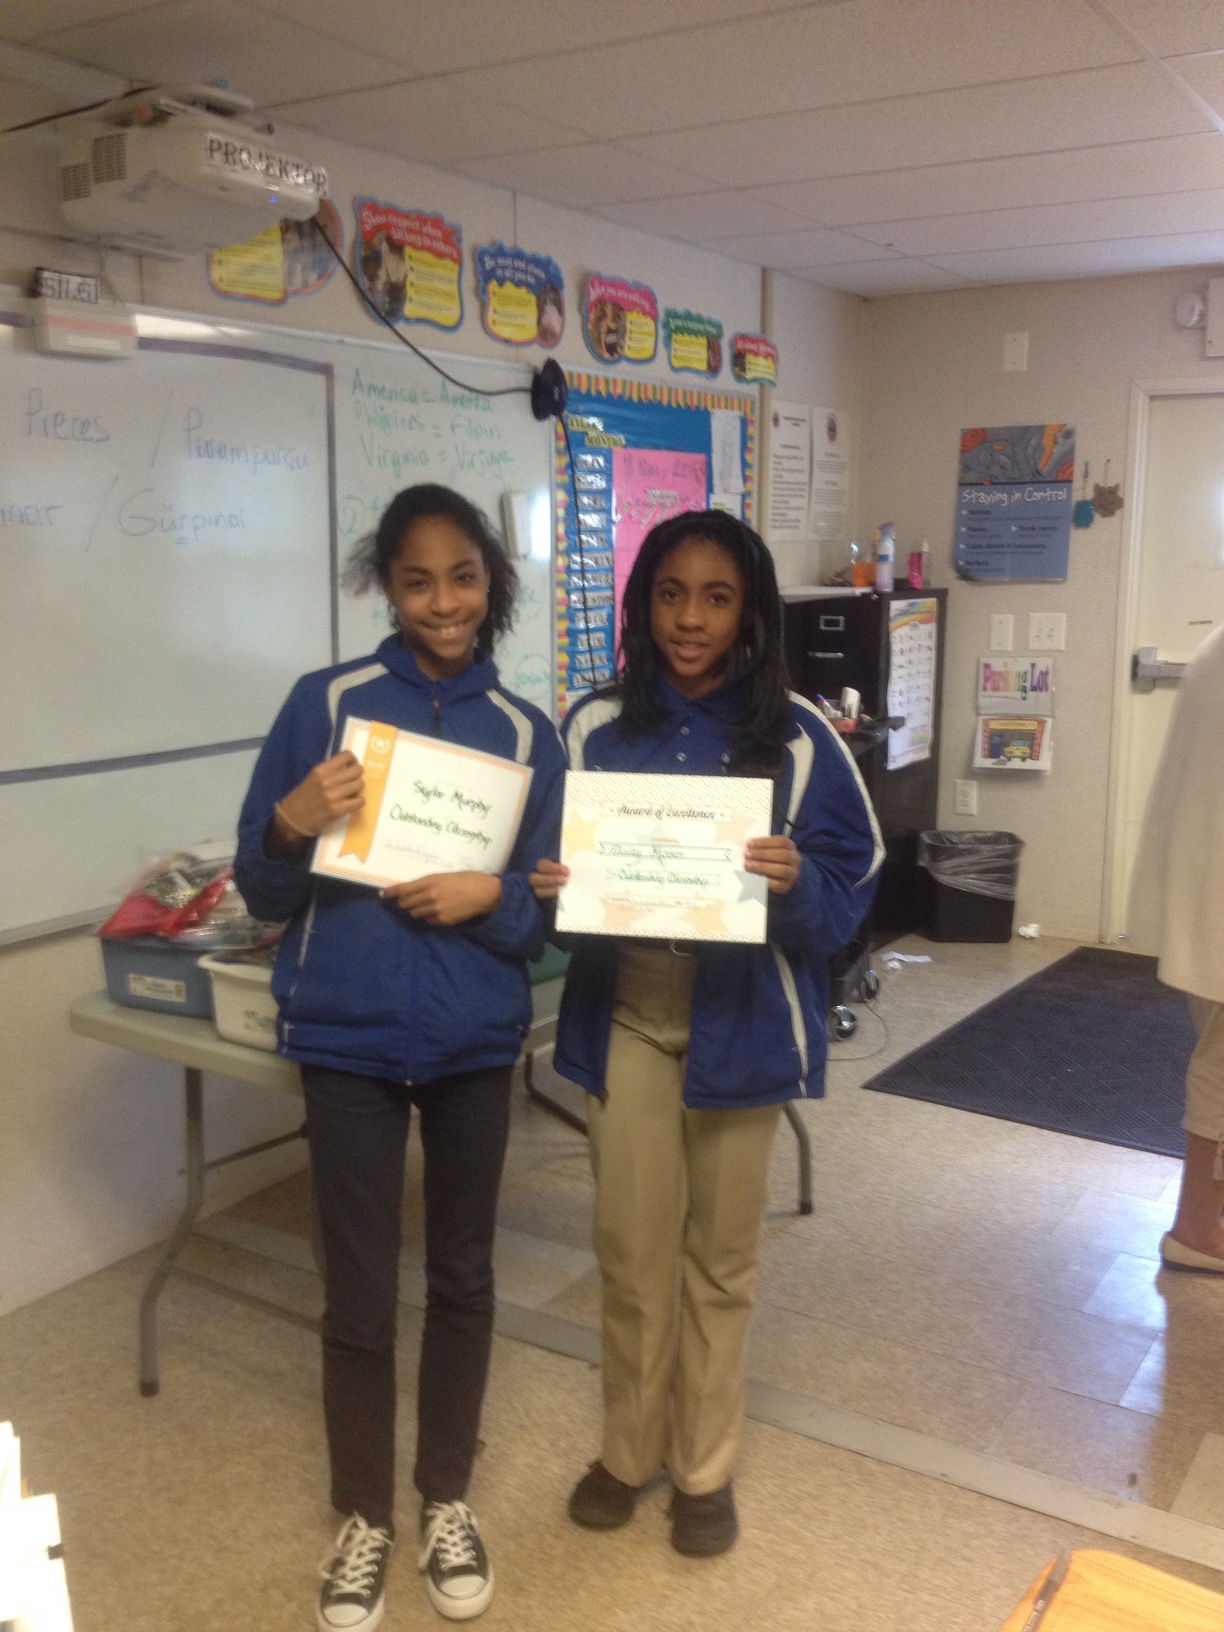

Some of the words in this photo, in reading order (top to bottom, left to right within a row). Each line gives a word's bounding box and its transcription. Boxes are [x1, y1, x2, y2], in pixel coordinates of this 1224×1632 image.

[961, 489, 1007, 507] Staying
[1010, 490, 1021, 503] in
[1024, 487, 1067, 502] Control
[982, 661, 1028, 700] Parking
[1029, 662, 1049, 692] Lot
[617, 803, 652, 818] Award
[654, 804, 666, 821] of
[666, 804, 716, 820] Excellence
